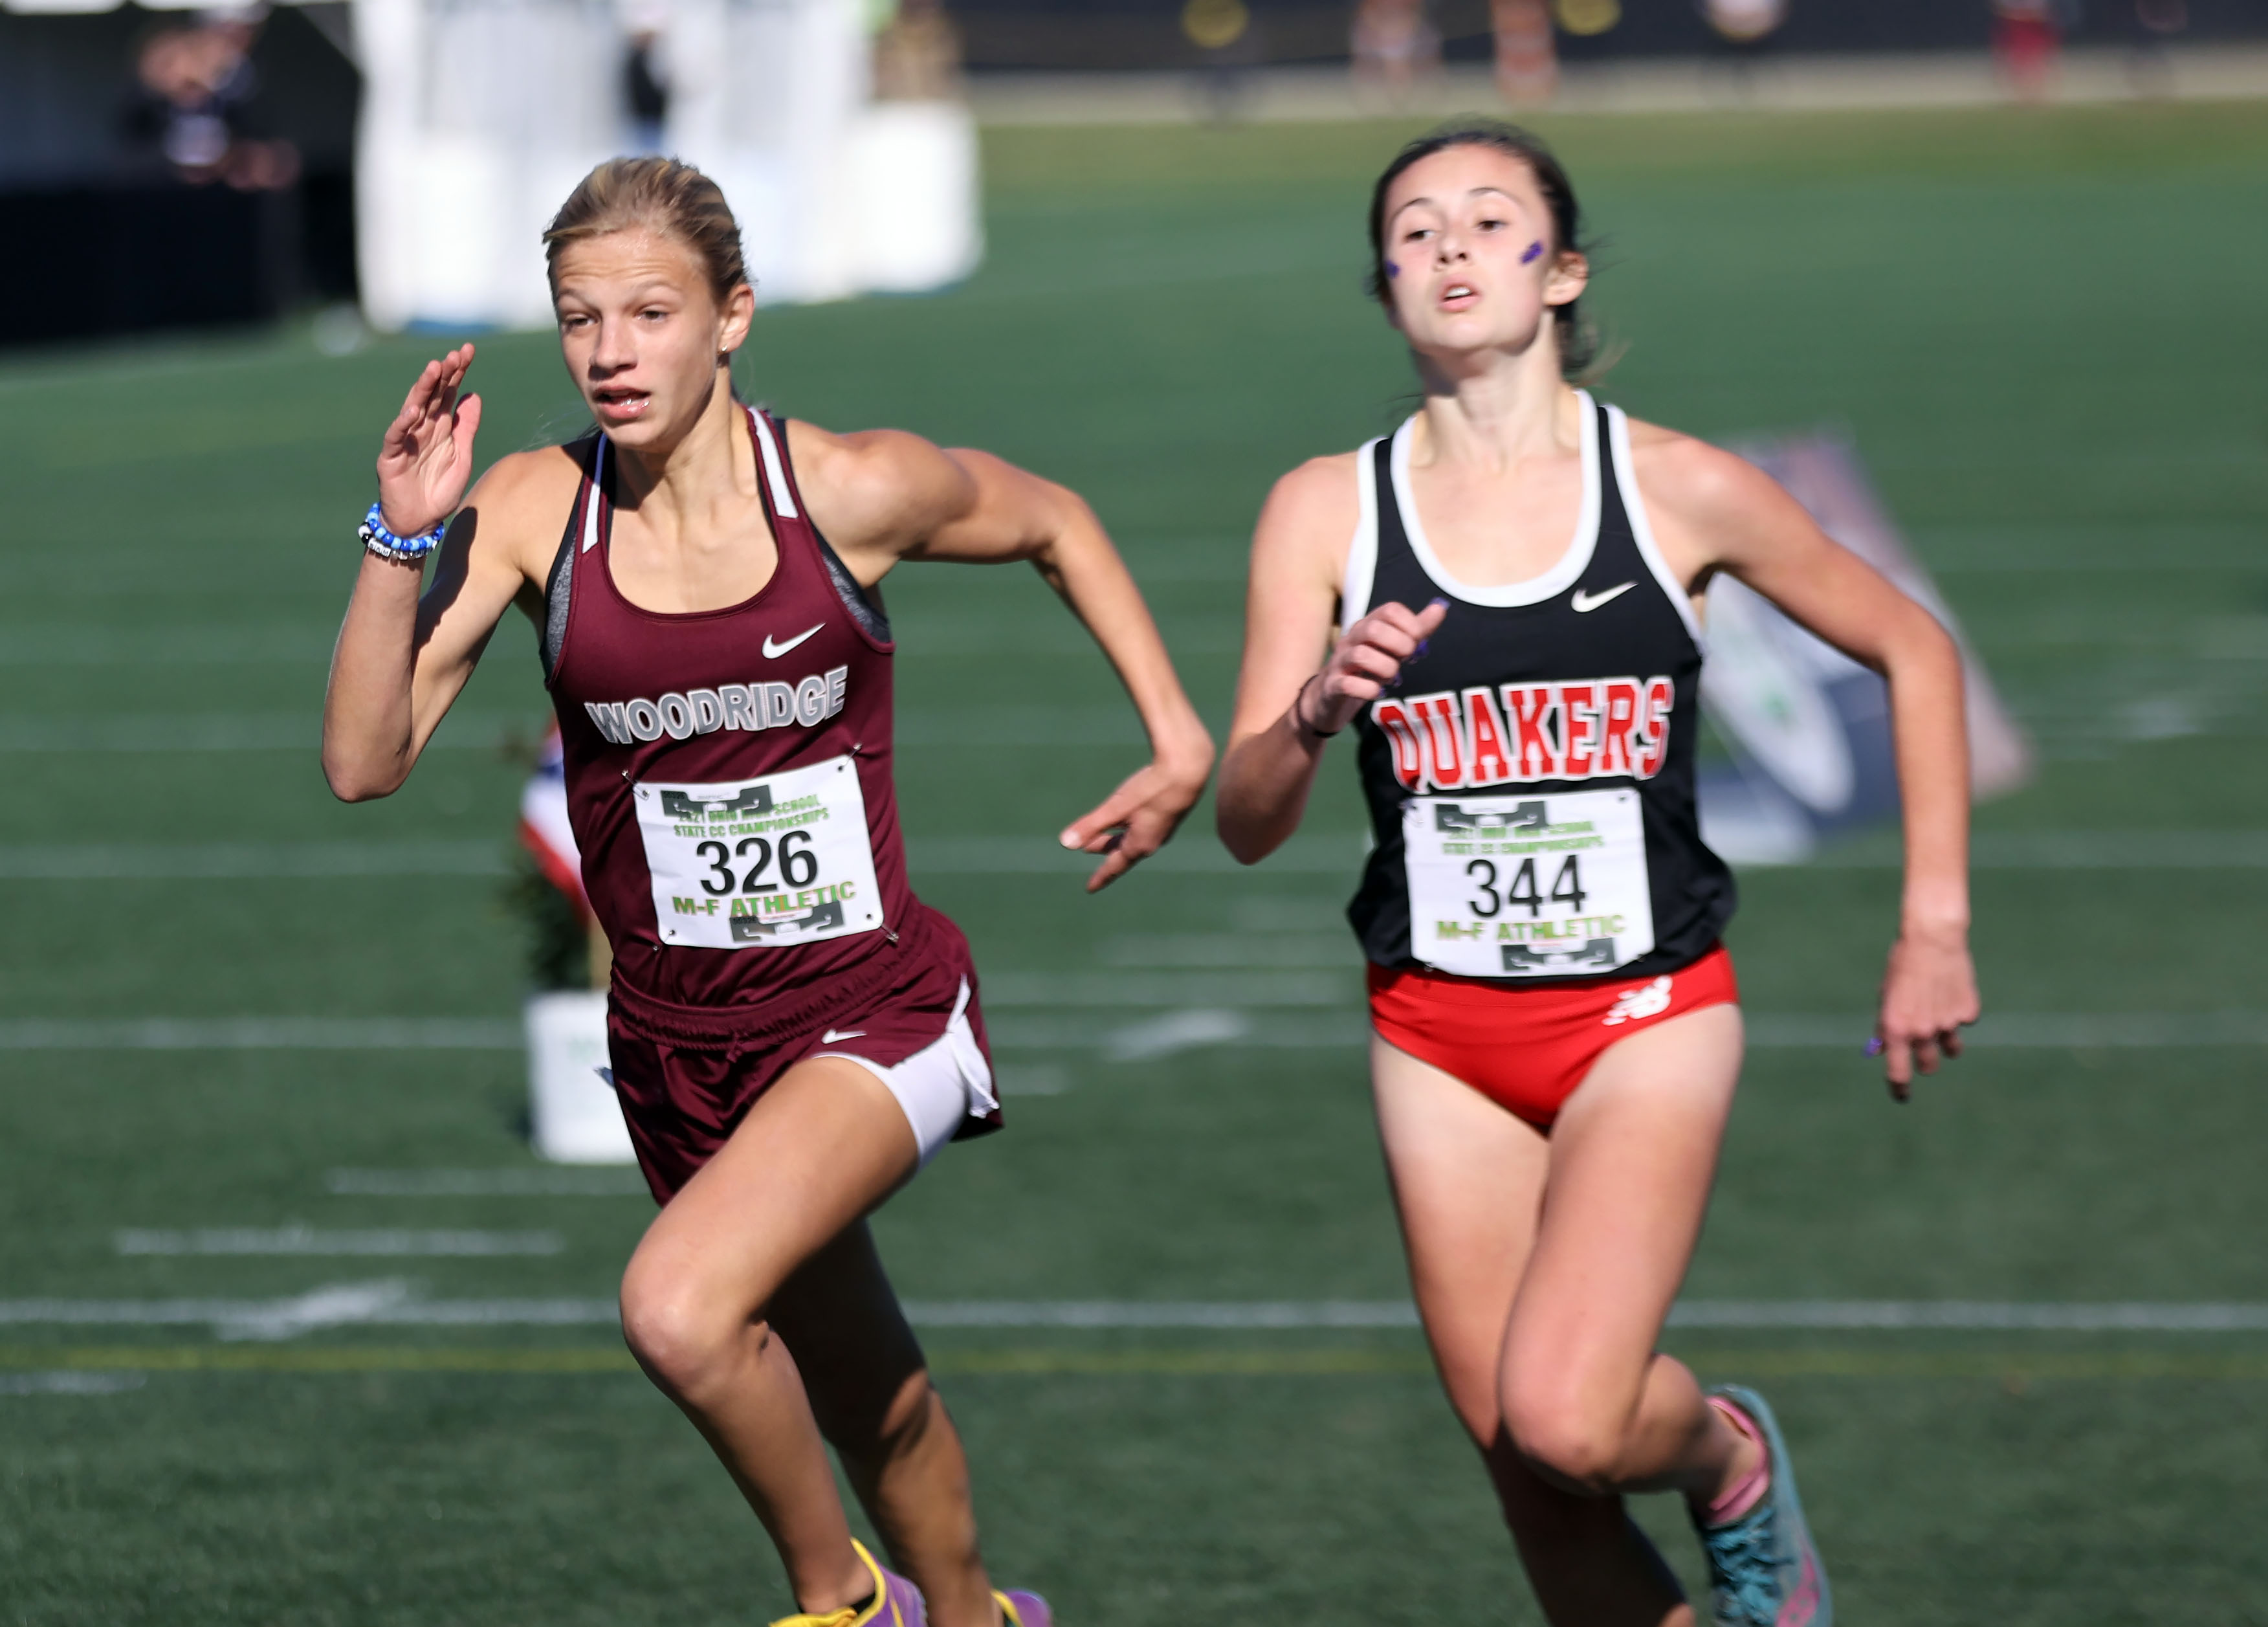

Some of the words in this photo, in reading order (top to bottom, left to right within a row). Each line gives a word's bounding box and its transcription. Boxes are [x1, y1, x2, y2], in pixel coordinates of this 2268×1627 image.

[583, 664, 848, 745] WOODRIDGE
[1371, 676, 1674, 795] QUAKERS
[673, 824, 707, 838] STATE
[709, 825, 727, 838] CC
[729, 807, 830, 837] CHAMPIONSHIPS
[696, 830, 818, 898] 326
[1468, 854, 1586, 918] 344
[672, 896, 720, 916] M-F
[731, 880, 857, 917] ATHLETIC
[1435, 920, 1486, 942] M-F
[1497, 914, 1627, 942] ATHLETIC
